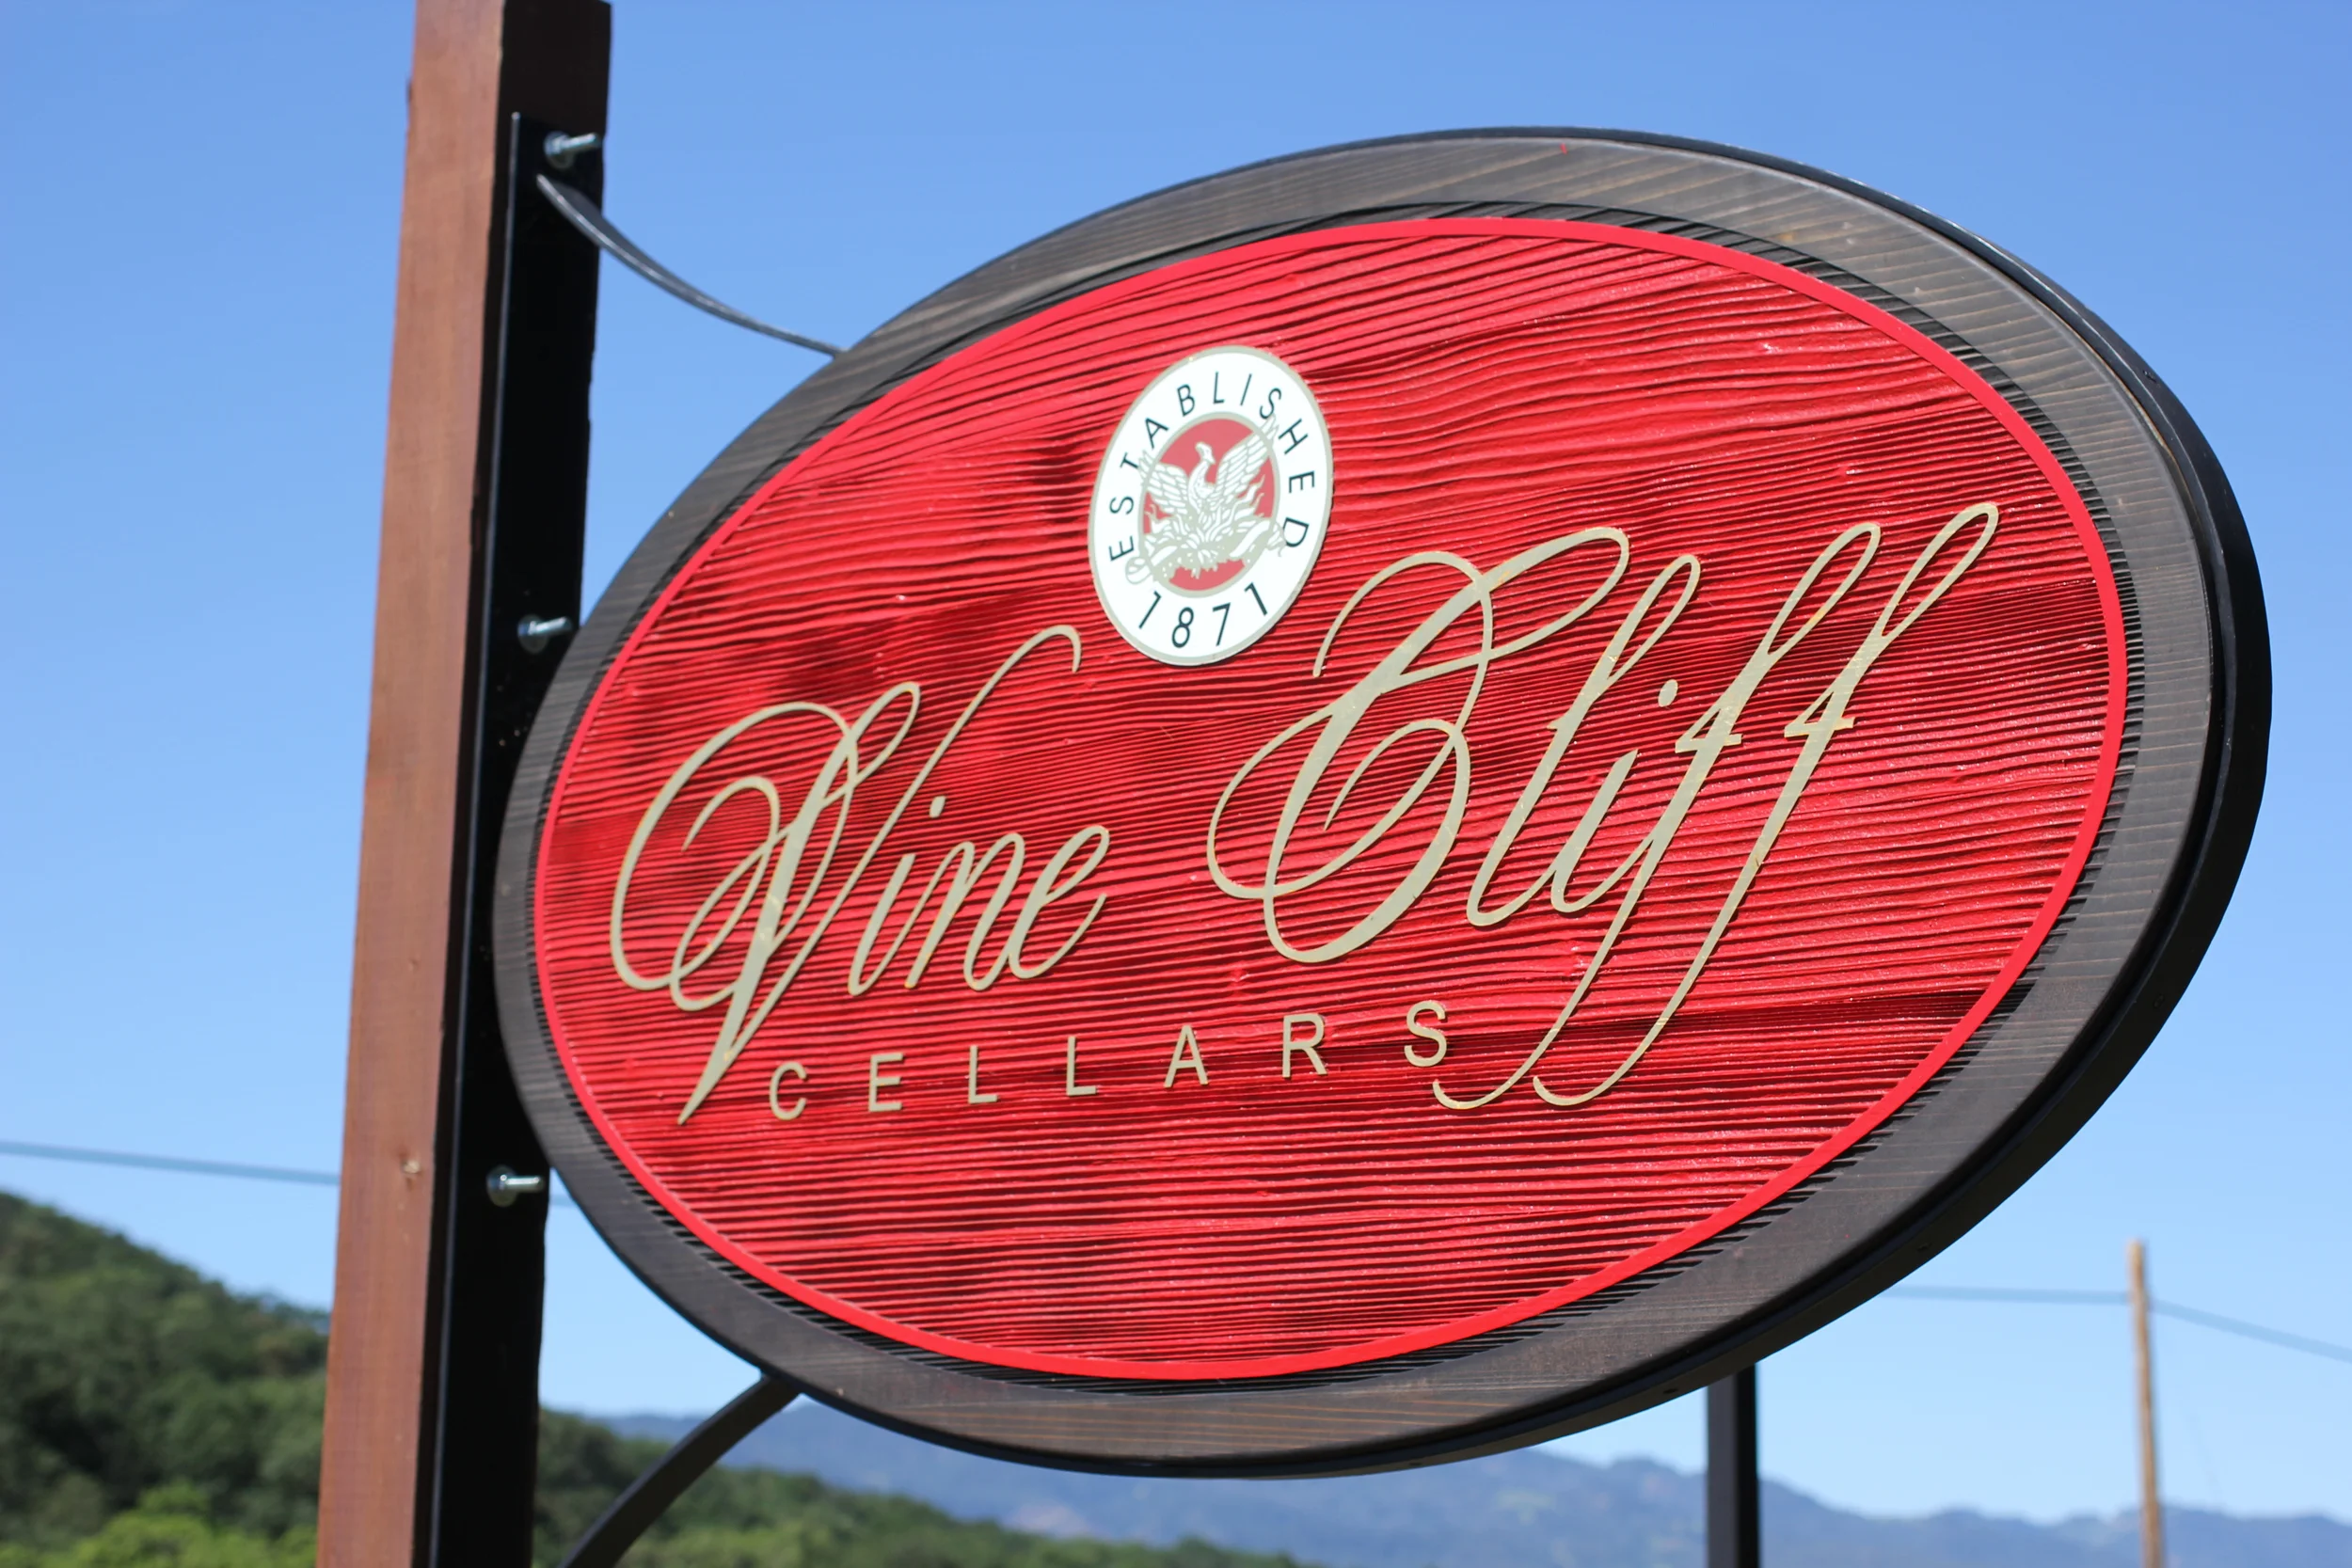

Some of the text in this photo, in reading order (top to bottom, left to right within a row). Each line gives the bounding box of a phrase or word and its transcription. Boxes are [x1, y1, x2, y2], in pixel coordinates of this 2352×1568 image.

[1109, 372, 1315, 562] ESTABLISHED
[1138, 582, 1268, 648] 1871
[610, 503, 1998, 1124] Vine Cliff
[769, 1000, 1448, 1120] CELLARS
